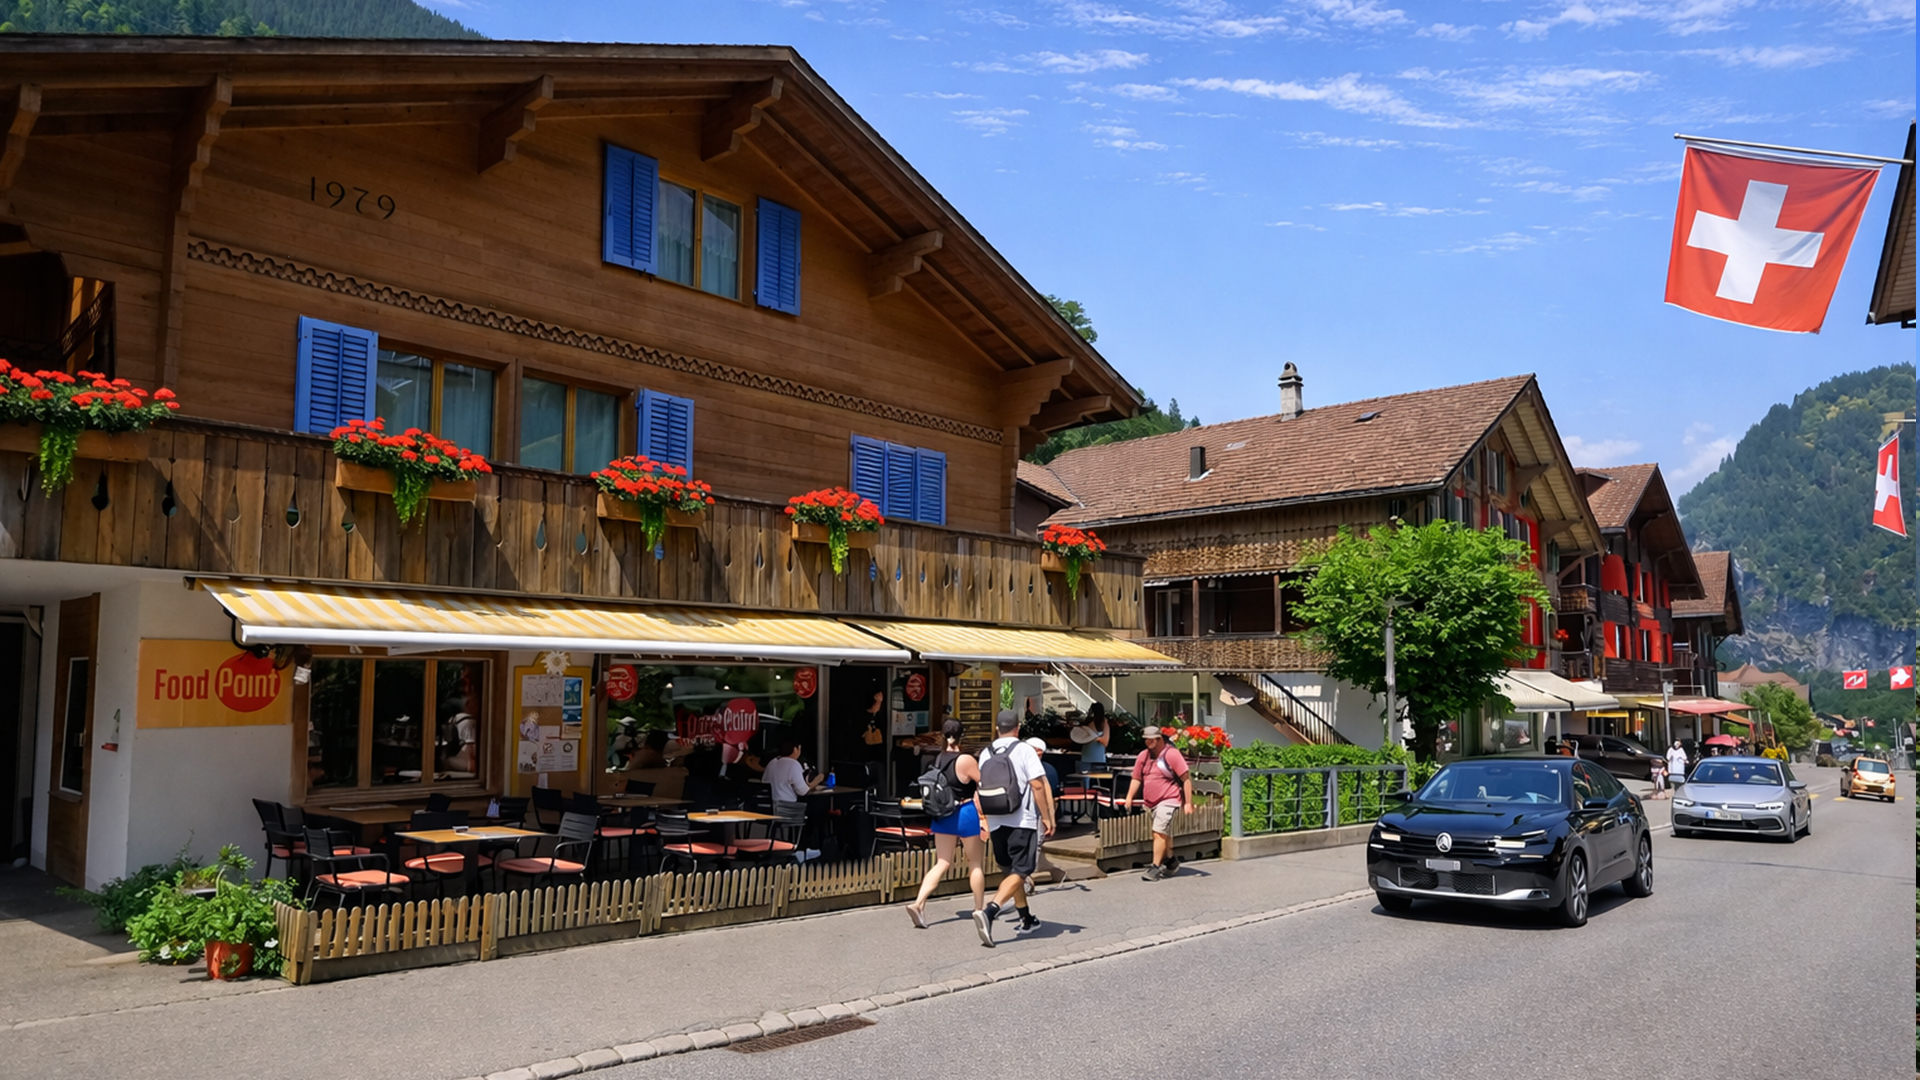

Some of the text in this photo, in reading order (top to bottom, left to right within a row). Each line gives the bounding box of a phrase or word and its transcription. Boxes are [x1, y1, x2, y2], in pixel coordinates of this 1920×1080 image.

[310, 176, 396, 220] 1979
[154, 667, 278, 700] Food Point
